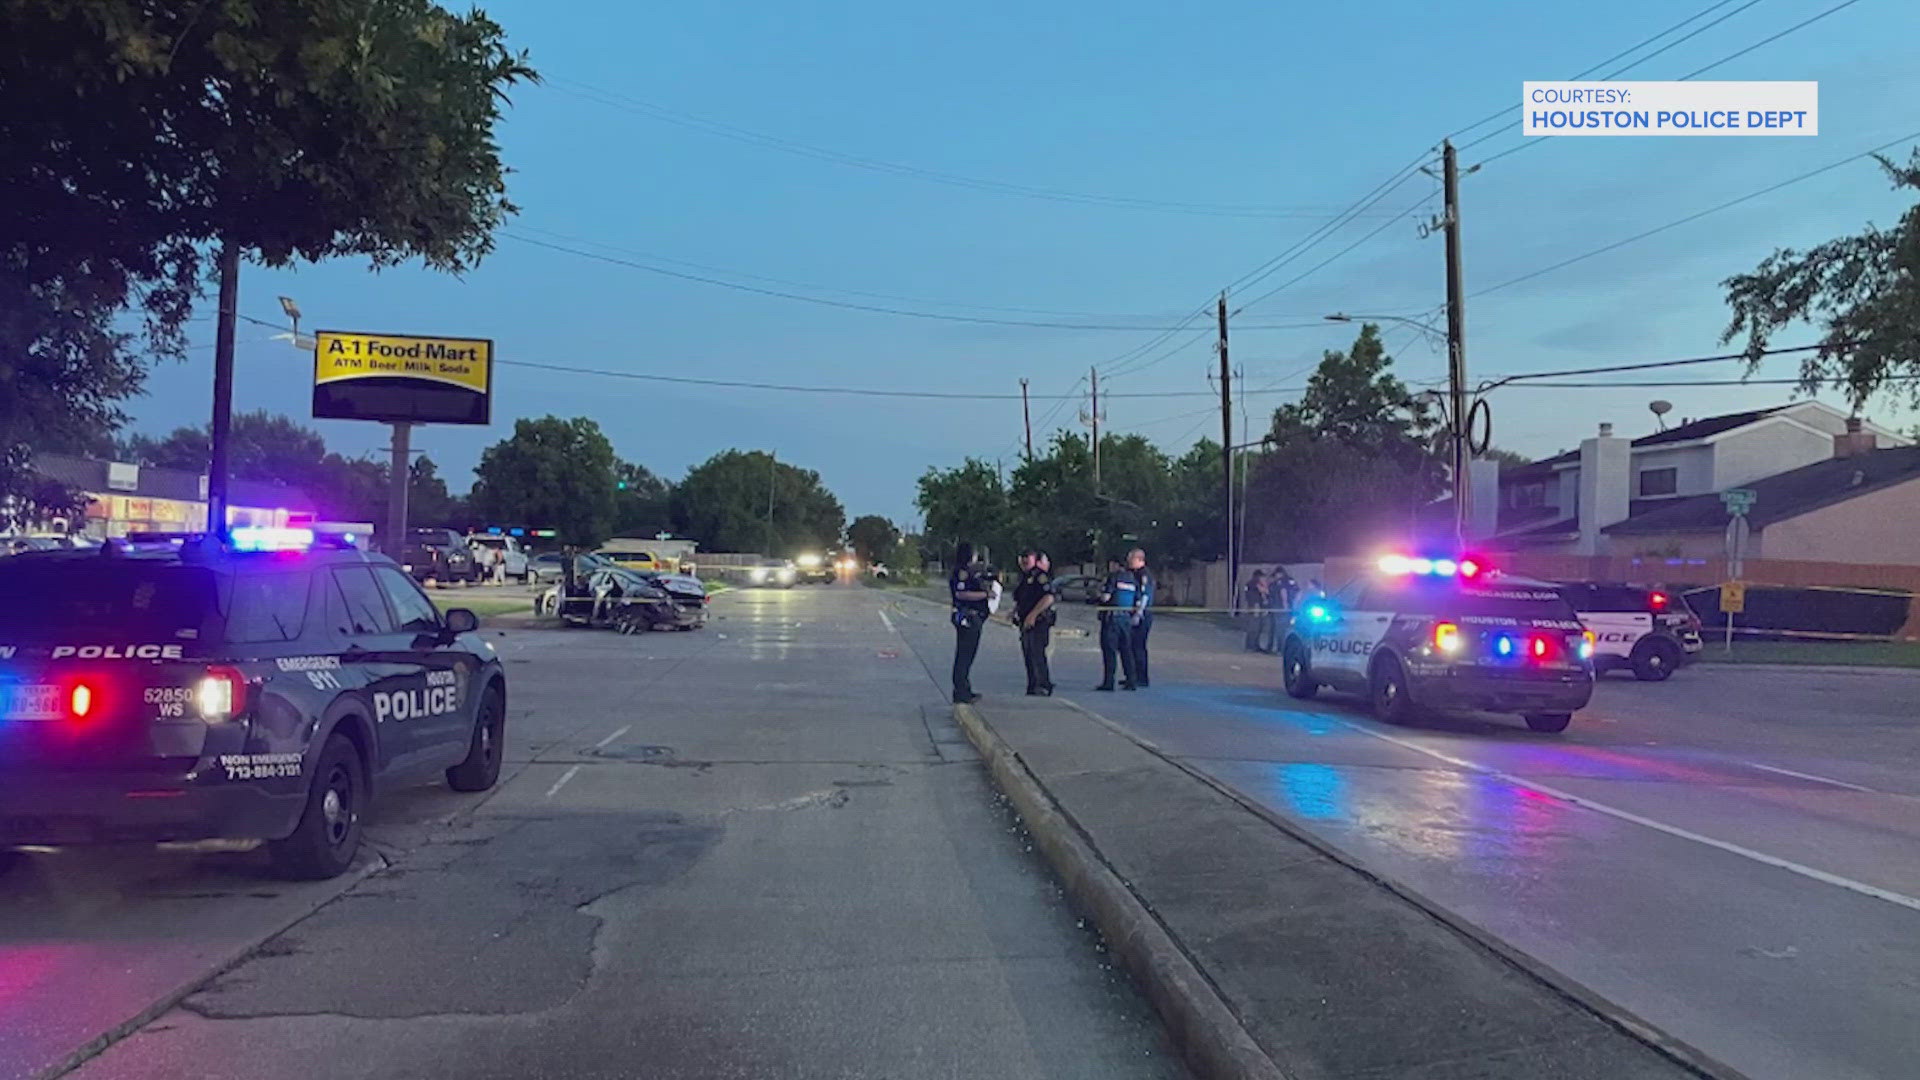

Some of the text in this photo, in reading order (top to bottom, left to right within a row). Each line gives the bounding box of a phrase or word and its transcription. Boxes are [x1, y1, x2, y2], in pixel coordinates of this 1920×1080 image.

[329, 339, 477, 361] A-1 Food Mart
[333, 357, 470, 374] ATM Beer Milk Soda
[1460, 615, 1582, 630] HOUSTON POLICE
[52, 645, 184, 659] POLICE
[1319, 638, 1373, 656] POLICE
[276, 657, 341, 671] EMERGENCY
[307, 671, 341, 690] 911
[158, 703, 184, 717] WS
[373, 686, 457, 723] POLICE
[220, 753, 303, 766] NON EMERGENCY
